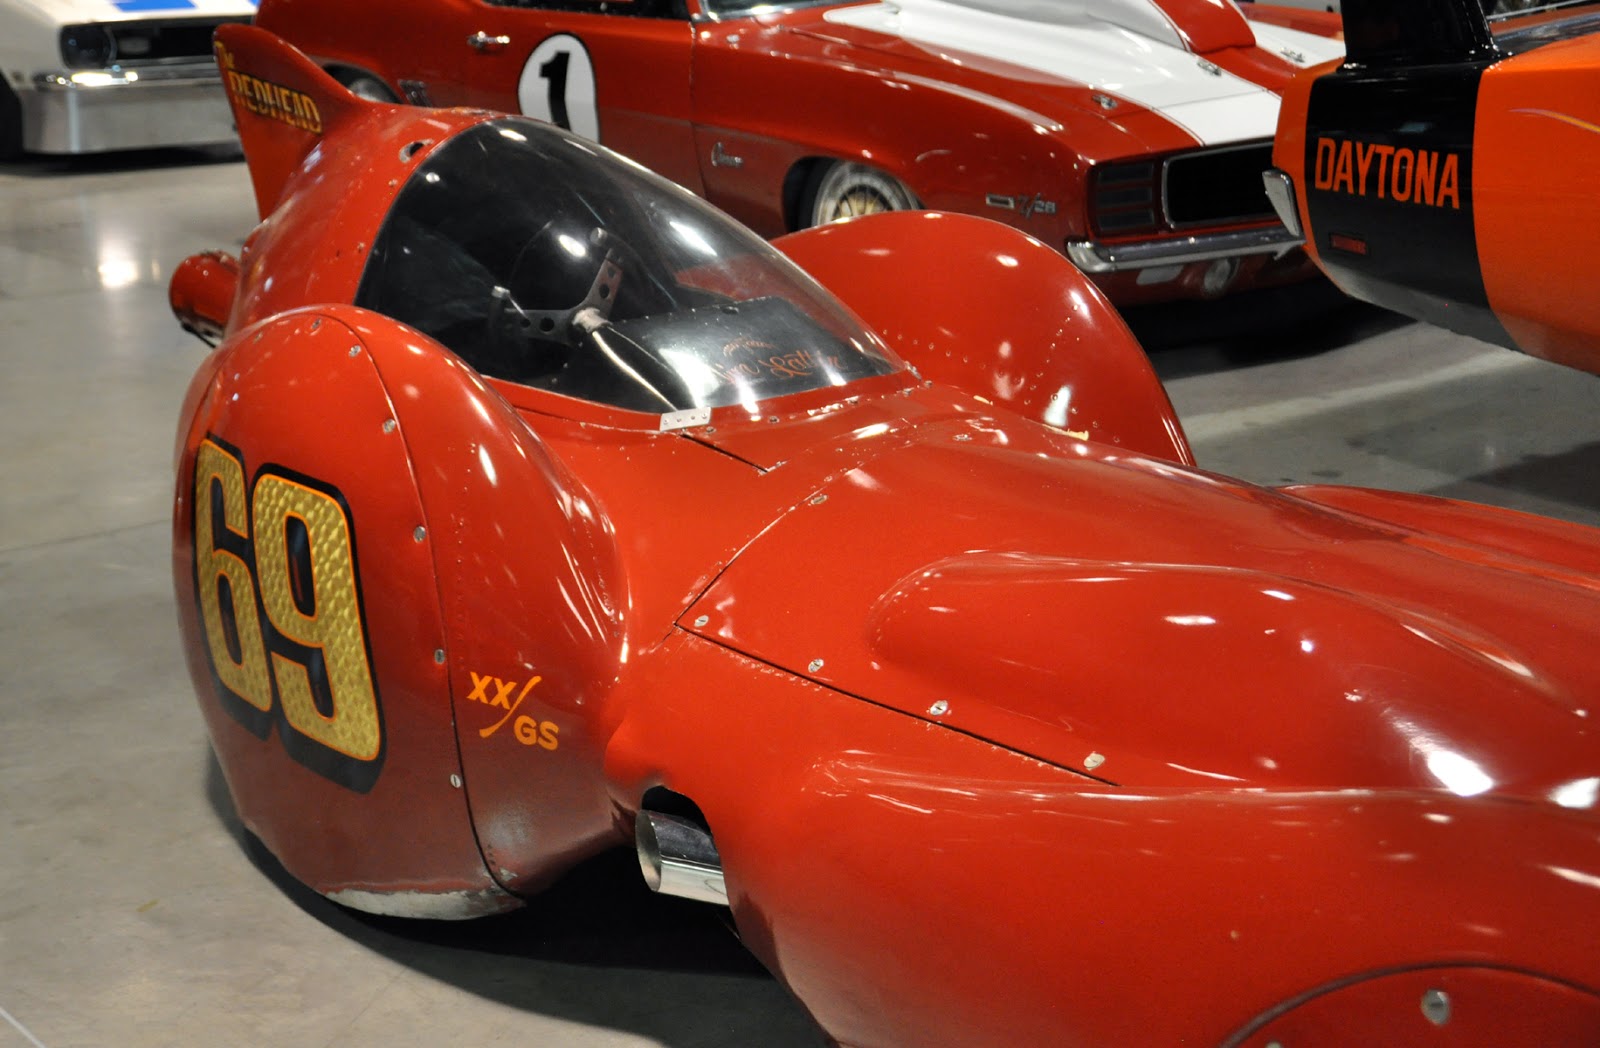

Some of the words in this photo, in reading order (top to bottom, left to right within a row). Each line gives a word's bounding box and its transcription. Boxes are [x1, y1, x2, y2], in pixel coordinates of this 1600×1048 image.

[226, 69, 323, 135] REDHEAD
[540, 51, 572, 131] 1
[1314, 137, 1460, 209] DAYTONA
[193, 435, 383, 767] 69
